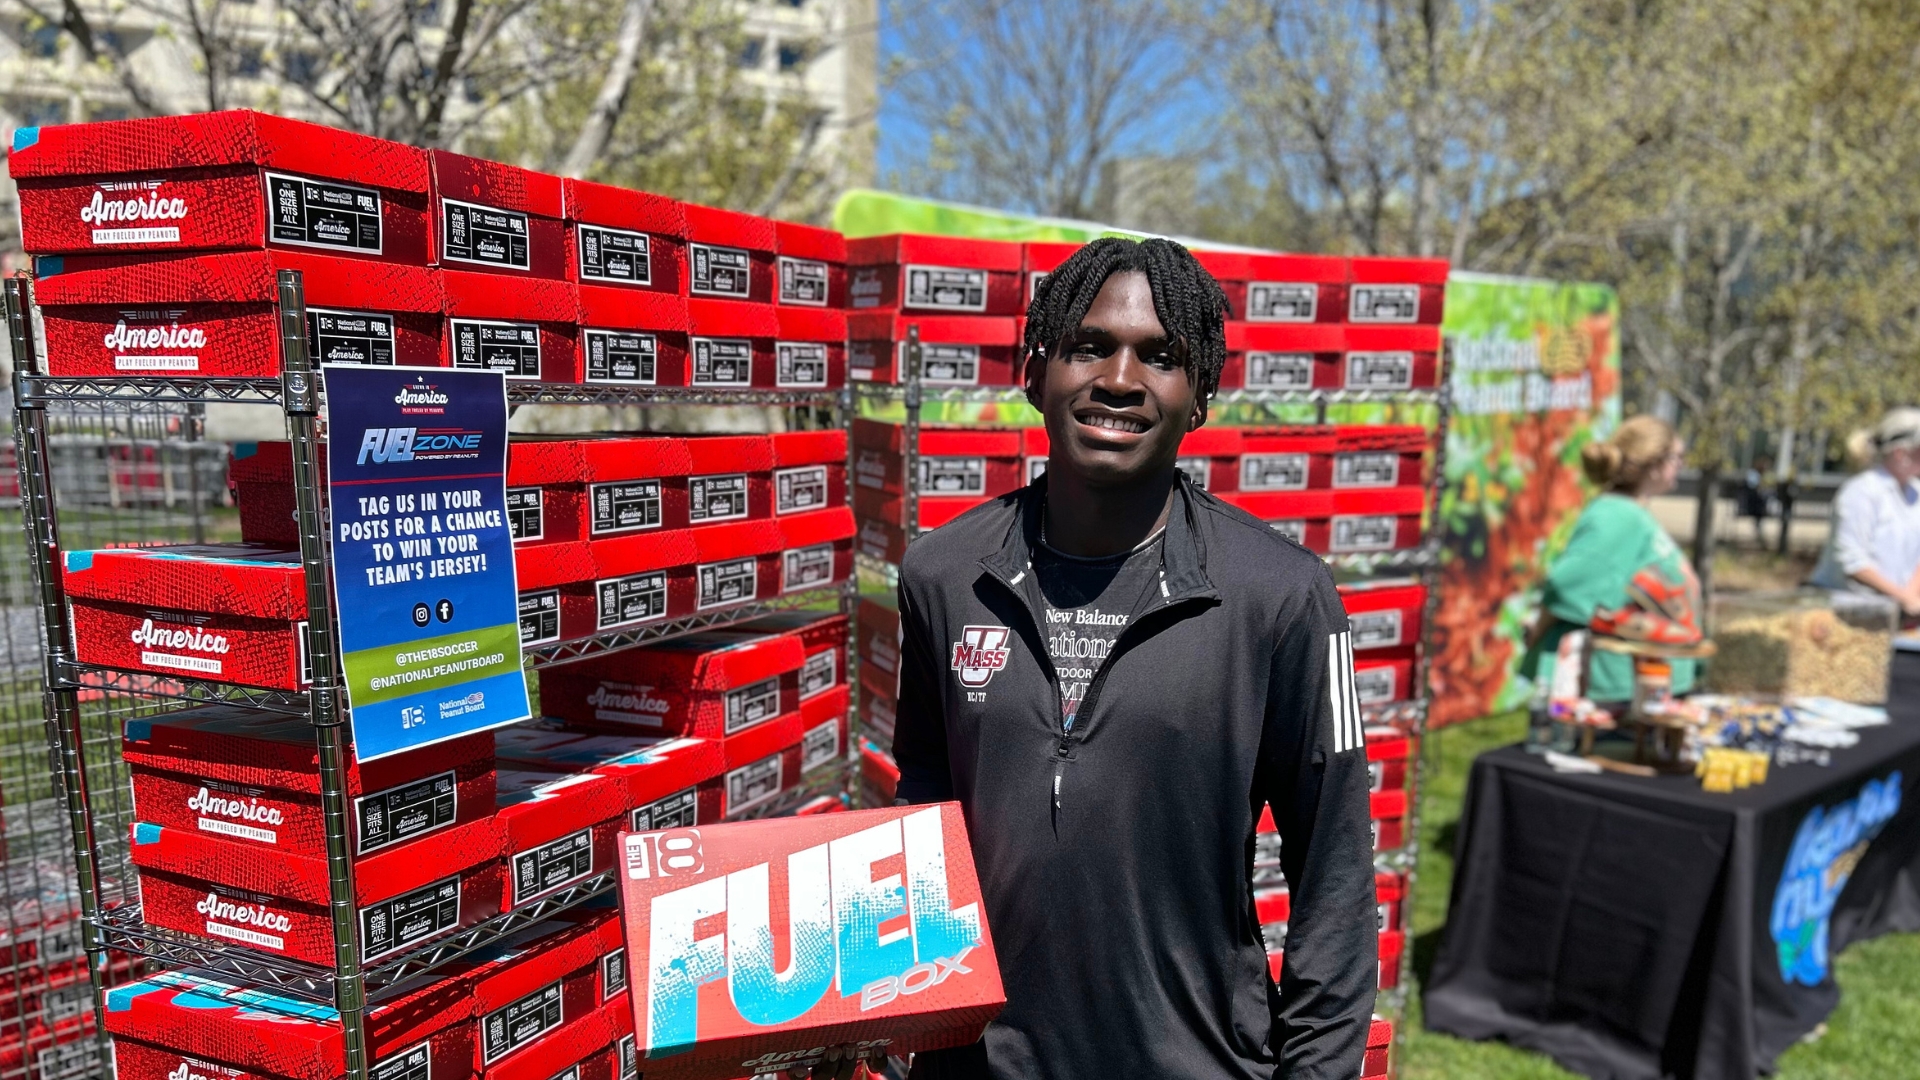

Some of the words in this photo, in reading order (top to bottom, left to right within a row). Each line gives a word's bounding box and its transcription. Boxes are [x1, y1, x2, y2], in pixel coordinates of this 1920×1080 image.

[279, 189, 296, 198] ONE
[280, 198, 297, 207] SIZE
[357, 195, 373, 207] FUEL
[81, 191, 188, 226] America
[281, 207, 298, 216] FITS
[283, 215, 297, 224] ALL
[452, 213, 464, 221] ONE
[314, 221, 351, 234] America
[452, 221, 465, 229] SIZE
[510, 219, 523, 229] FUEL
[96, 232, 110, 240] PLAY
[113, 231, 135, 240] FUELED
[138, 231, 146, 239] BY
[148, 230, 177, 239] PEANUTS
[452, 228, 465, 237] FITS
[453, 236, 464, 244] ALL
[477, 241, 505, 253] America
[138, 311, 159, 319] GROWN
[161, 311, 169, 319] IN
[371, 322, 386, 332] FUEL
[104, 319, 207, 352] America
[521, 331, 534, 340] FUEL
[328, 349, 364, 360] America
[169, 359, 195, 367] PEANUTS
[395, 388, 449, 406] America
[357, 427, 417, 466] FUEL
[413, 435, 482, 450] ZONE
[359, 496, 390, 516] TAG
[396, 494, 415, 513] US
[421, 493, 437, 511] IN
[442, 490, 482, 509] YOUR
[524, 494, 536, 503] FUEL
[340, 519, 389, 542] POSTS
[395, 516, 426, 536] FOR
[431, 515, 442, 533] A
[446, 510, 502, 531] CHANCE
[372, 542, 394, 562] TO
[399, 538, 432, 559] WIN
[437, 534, 478, 554] YOUR
[366, 562, 424, 586] TEAM'S
[429, 554, 487, 578] JERSEY!
[542, 596, 554, 606] FUEL
[163, 612, 184, 622] GROWN
[187, 615, 194, 623] IN
[1046, 609, 1073, 624] New
[131, 618, 230, 654] America
[1049, 630, 1117, 658] ationa
[396, 641, 478, 666] @THE18SOCCER
[952, 645, 1008, 670] MASS
[145, 654, 158, 662] PLAY
[161, 656, 181, 665] FUELED
[184, 659, 191, 667] BY
[193, 660, 219, 671] PEANUTS
[370, 653, 505, 690] @NATIONALPEANUTBOARD
[1055, 668, 1092, 678] TDOOR
[587, 686, 670, 713] America
[967, 692, 986, 702] XC/TF
[439, 697, 468, 710] National
[440, 706, 464, 719] Peanut
[465, 701, 485, 713] Board
[435, 779, 449, 791] FUEL
[188, 787, 284, 825] America
[366, 805, 381, 815] ONE
[367, 812, 382, 822] SIZE
[396, 814, 428, 829] America
[201, 820, 215, 829] PLAY
[217, 823, 237, 833] FUELED
[239, 827, 247, 835] BY
[248, 829, 273, 840] PEANUTS
[368, 820, 382, 829] FITS
[369, 827, 381, 836] ALL
[575, 835, 587, 846] FUEL
[626, 845, 643, 869] THE
[643, 830, 702, 879] 18
[522, 860, 534, 869] ONE
[522, 867, 534, 876] SIZE
[523, 873, 534, 882] FITS
[523, 880, 533, 888] ALL
[196, 892, 292, 932] America
[370, 913, 385, 924] ONE
[371, 920, 386, 930] SIZE
[210, 924, 223, 933] PLAY
[225, 927, 245, 938] FUELED
[247, 932, 254, 940] BY
[256, 935, 281, 947] PEANUTS
[371, 927, 386, 938] FITS
[645, 805, 984, 1060] FUEL
[372, 935, 385, 944] ALL
[861, 947, 974, 1012] BOX
[491, 1018, 502, 1028] ONE
[491, 1024, 503, 1035] SIZE
[492, 1031, 503, 1041] FITS
[493, 1038, 503, 1046] ALL
[409, 1051, 423, 1065] FUEL
[742, 1038, 893, 1067] Ameca
